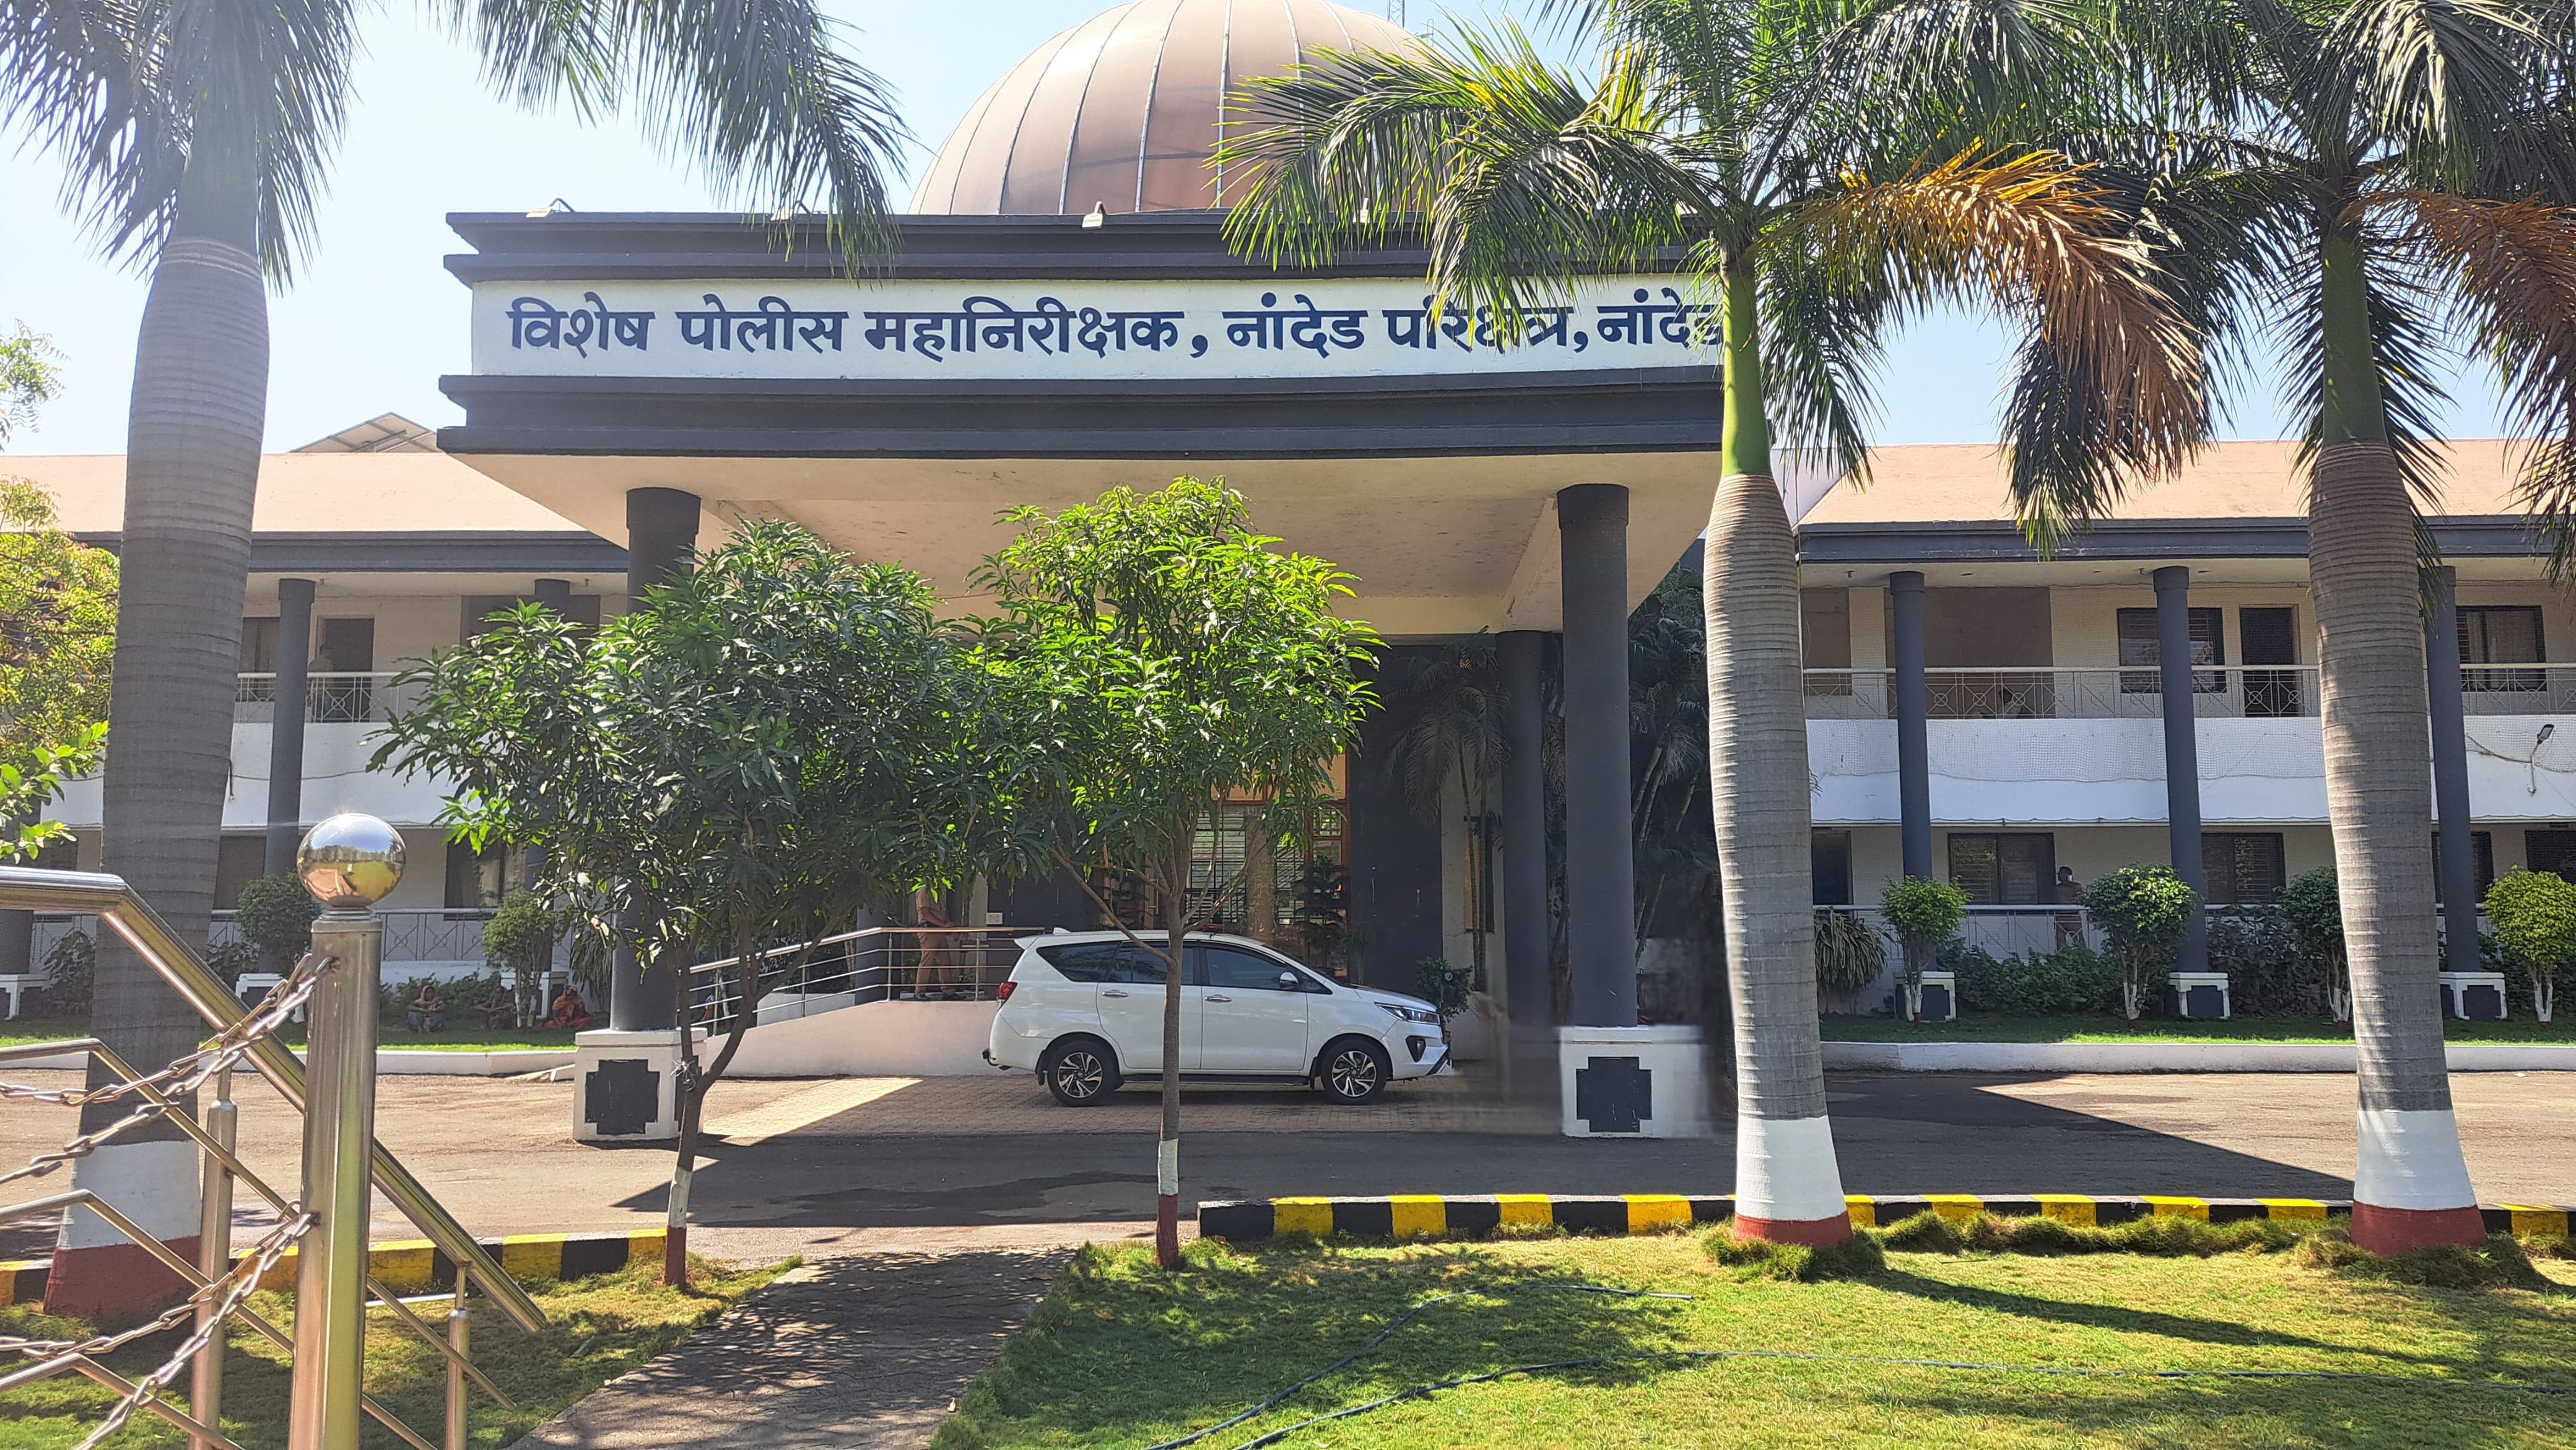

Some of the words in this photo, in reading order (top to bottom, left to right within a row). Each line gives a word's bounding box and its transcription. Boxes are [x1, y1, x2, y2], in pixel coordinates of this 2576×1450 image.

[506, 292, 656, 359] विशेष
[674, 293, 850, 354] पोलीस
[1222, 292, 1368, 359] नांदेड
